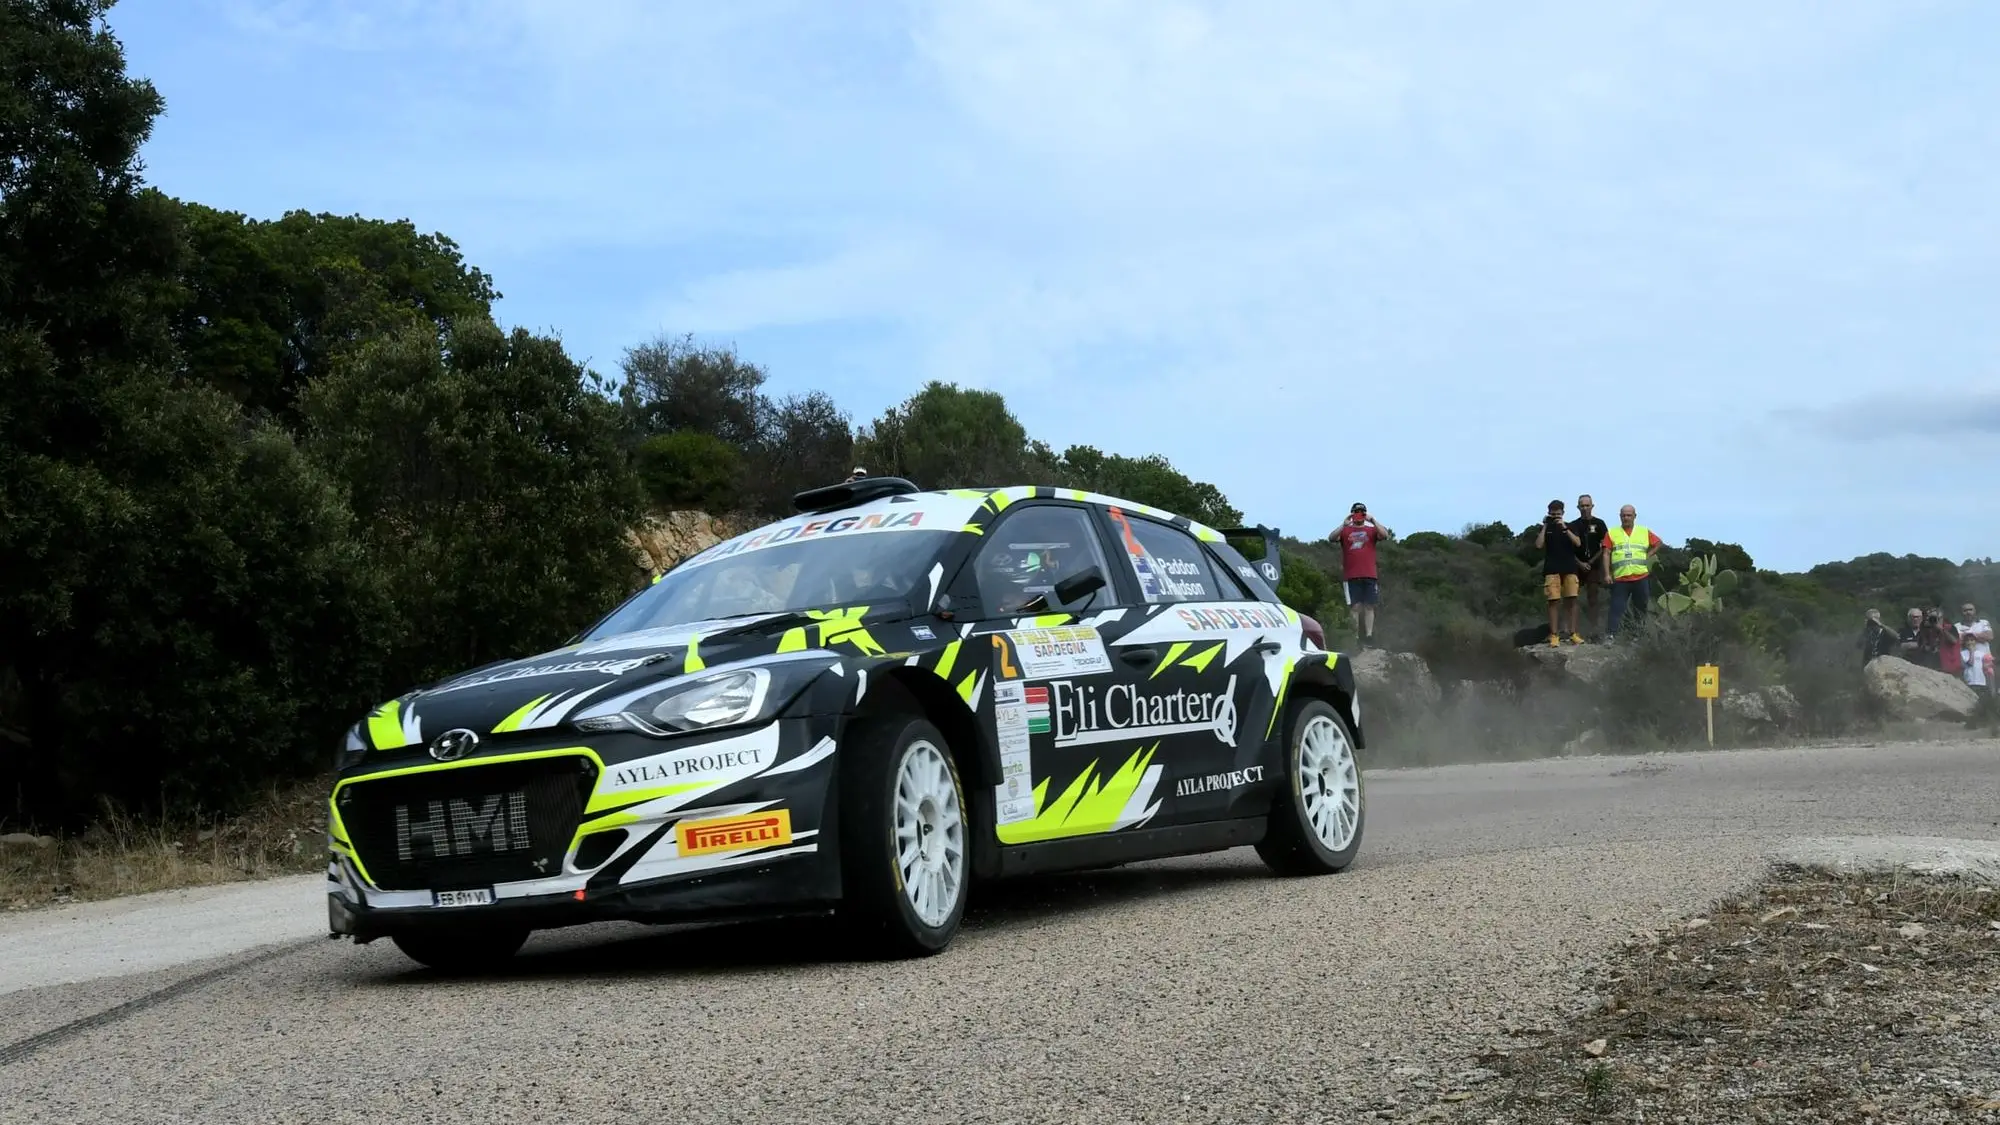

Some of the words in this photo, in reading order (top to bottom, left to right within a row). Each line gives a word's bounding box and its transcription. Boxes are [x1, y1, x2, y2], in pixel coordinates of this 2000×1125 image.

[1177, 608, 1288, 631] SARDEGNA
[991, 634, 1018, 678] 2
[1034, 642, 1088, 658] SARDEGNA
[1049, 680, 1100, 741] Eli
[1104, 683, 1213, 729] Charter
[614, 765, 668, 787] AYLA
[673, 749, 761, 776] PROJECT
[1176, 777, 1205, 797] AYLA
[1206, 765, 1264, 792] PROJECT
[396, 791, 532, 860] HMI
[685, 817, 780, 850] PIRELLI
